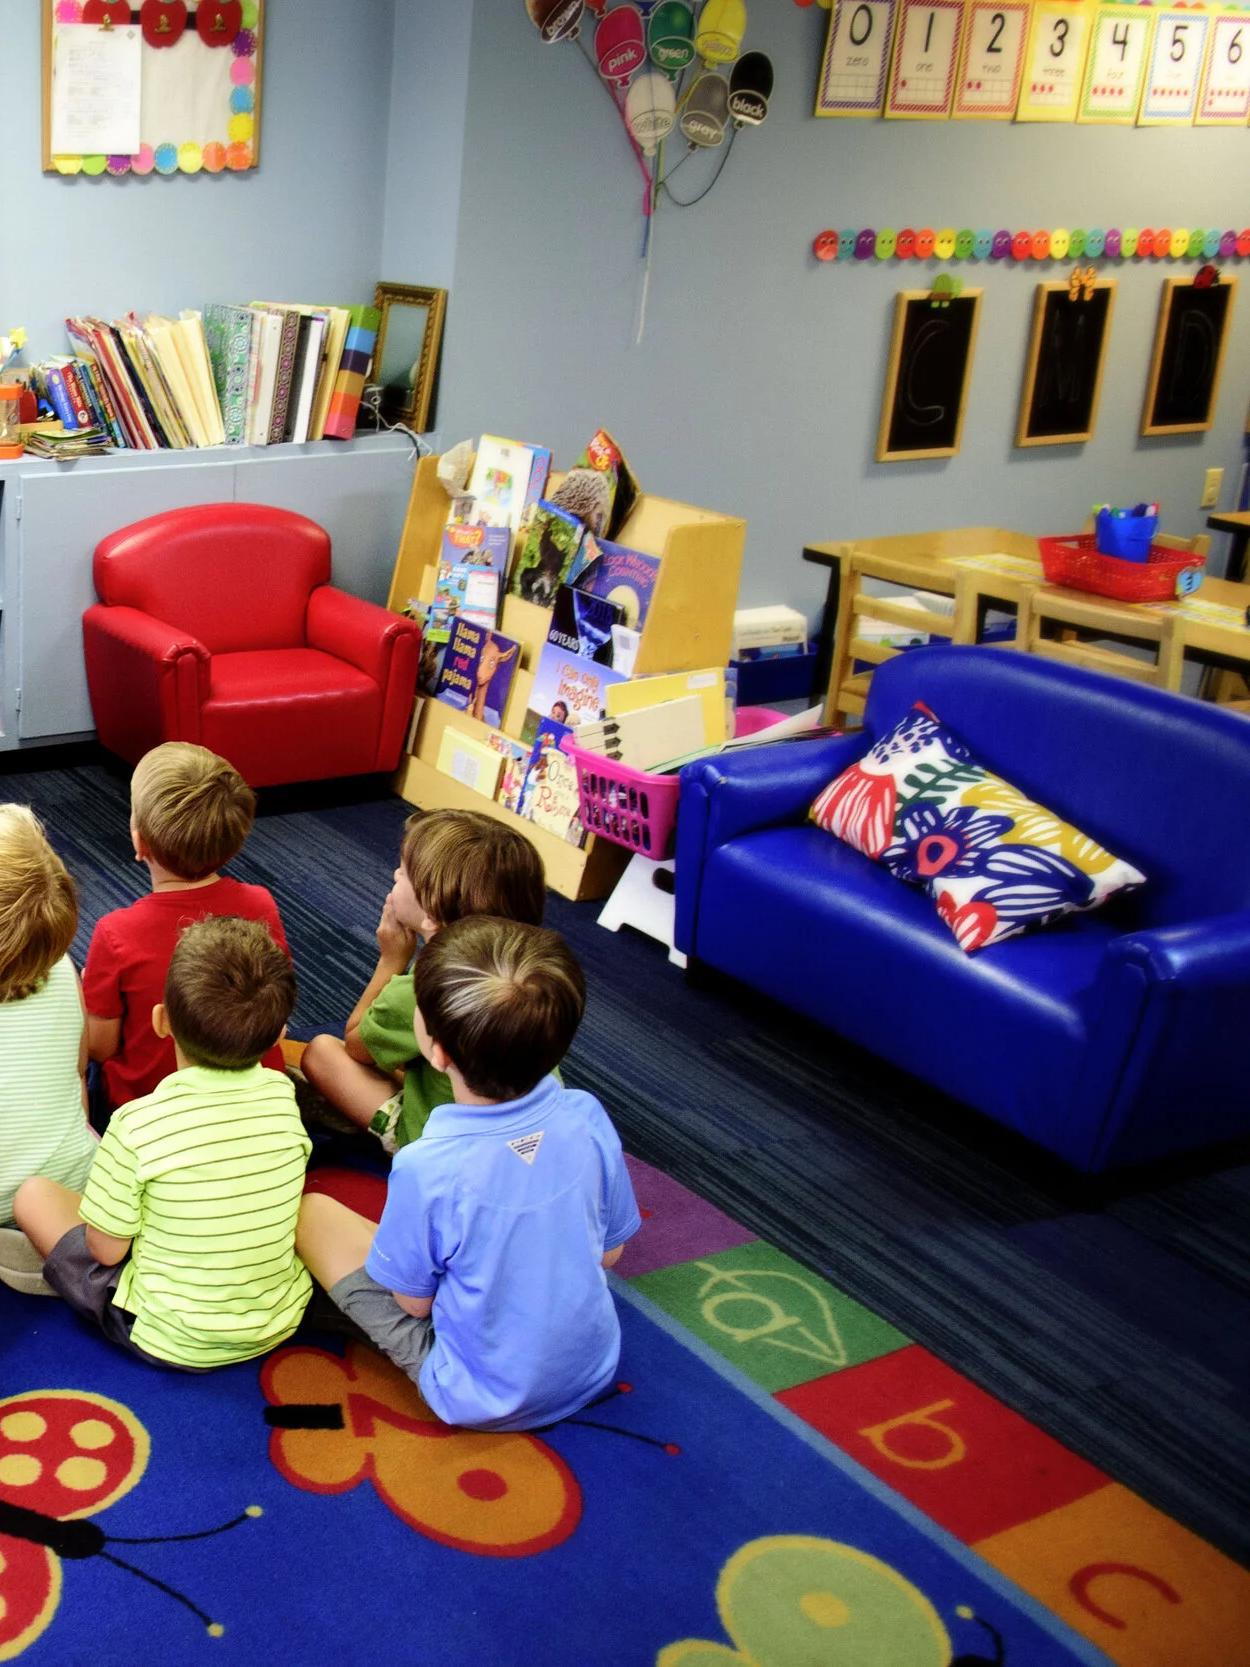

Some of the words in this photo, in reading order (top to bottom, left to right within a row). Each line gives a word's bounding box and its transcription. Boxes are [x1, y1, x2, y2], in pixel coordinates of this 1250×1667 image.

[850, 4, 873, 46] 0
[924, 11, 936, 53] 1
[986, 12, 1007, 54] 2
[1050, 18, 1070, 58] 3
[1111, 23, 1130, 62] 4
[1170, 25, 1190, 63] 5
[1227, 28, 1243, 65] 6
[608, 48, 638, 72] pink
[658, 44, 689, 63] green
[844, 55, 869, 67] zero
[915, 61, 934, 73] one
[982, 62, 1002, 74] two
[1042, 65, 1065, 78] three
[731, 98, 765, 119] black
[688, 119, 719, 140] gray
[587, 601, 614, 626] 2018
[456, 622, 480, 643] llama
[549, 629, 559, 643] 60
[558, 631, 580, 652] YEARS
[453, 637, 477, 659] llama
[453, 656, 469, 671] red
[441, 668, 473, 691] pajama
[555, 660, 562, 674] I
[561, 664, 579, 683] Can
[581, 668, 599, 694] Only
[557, 677, 599, 713] Imagine
[548, 760, 575, 792] Once
[700, 1290, 802, 1343] a
[858, 1399, 966, 1470] b
[1068, 1562, 1182, 1631] c
